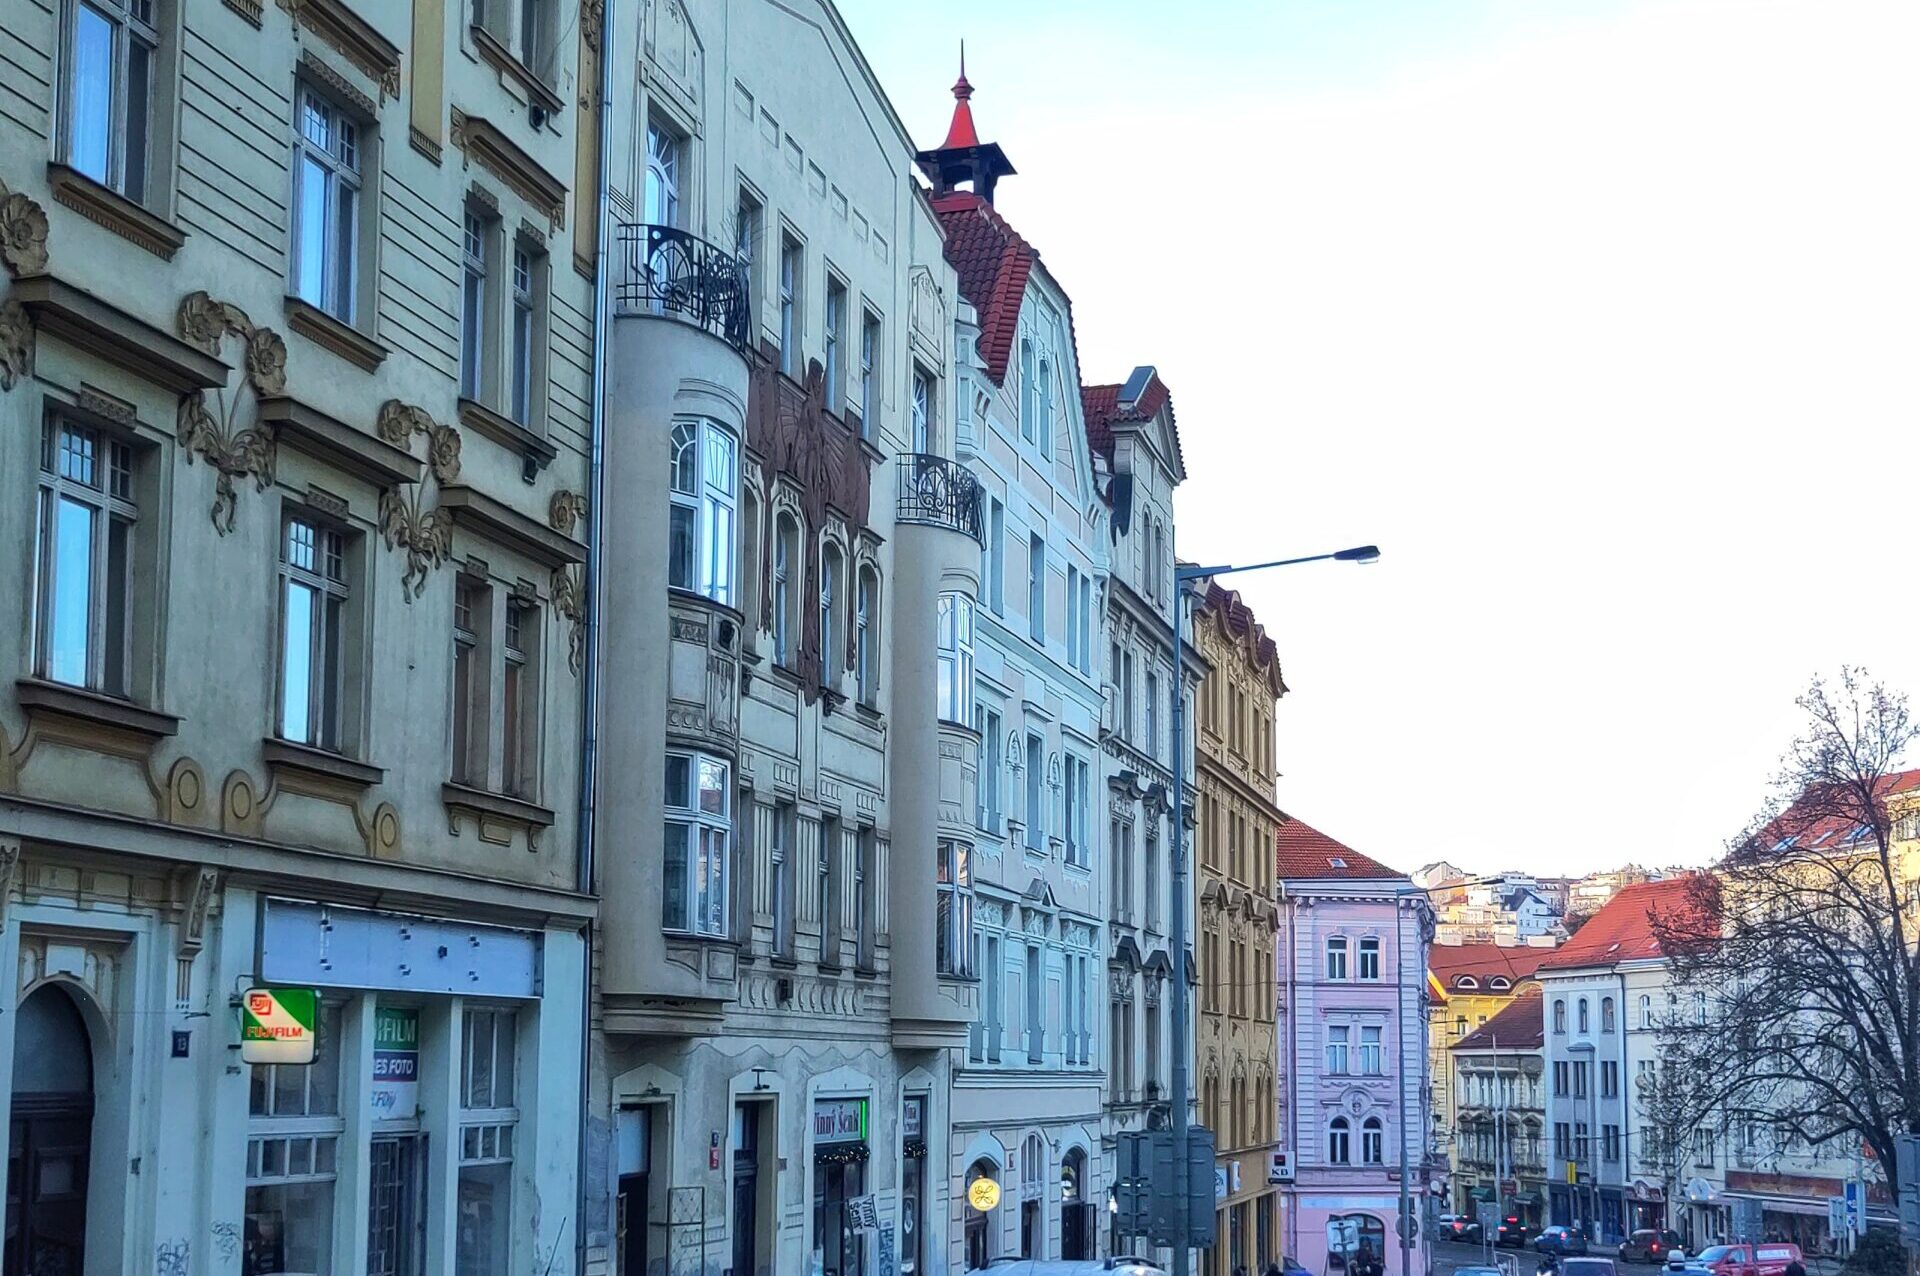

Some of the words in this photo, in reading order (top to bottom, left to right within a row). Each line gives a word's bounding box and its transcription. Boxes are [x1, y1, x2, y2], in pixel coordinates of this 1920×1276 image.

[247, 1025, 303, 1038] FUJIFILM
[374, 1058, 388, 1074] ES
[388, 1059, 414, 1075] FOTO
[1271, 1168, 1289, 1176] KB
